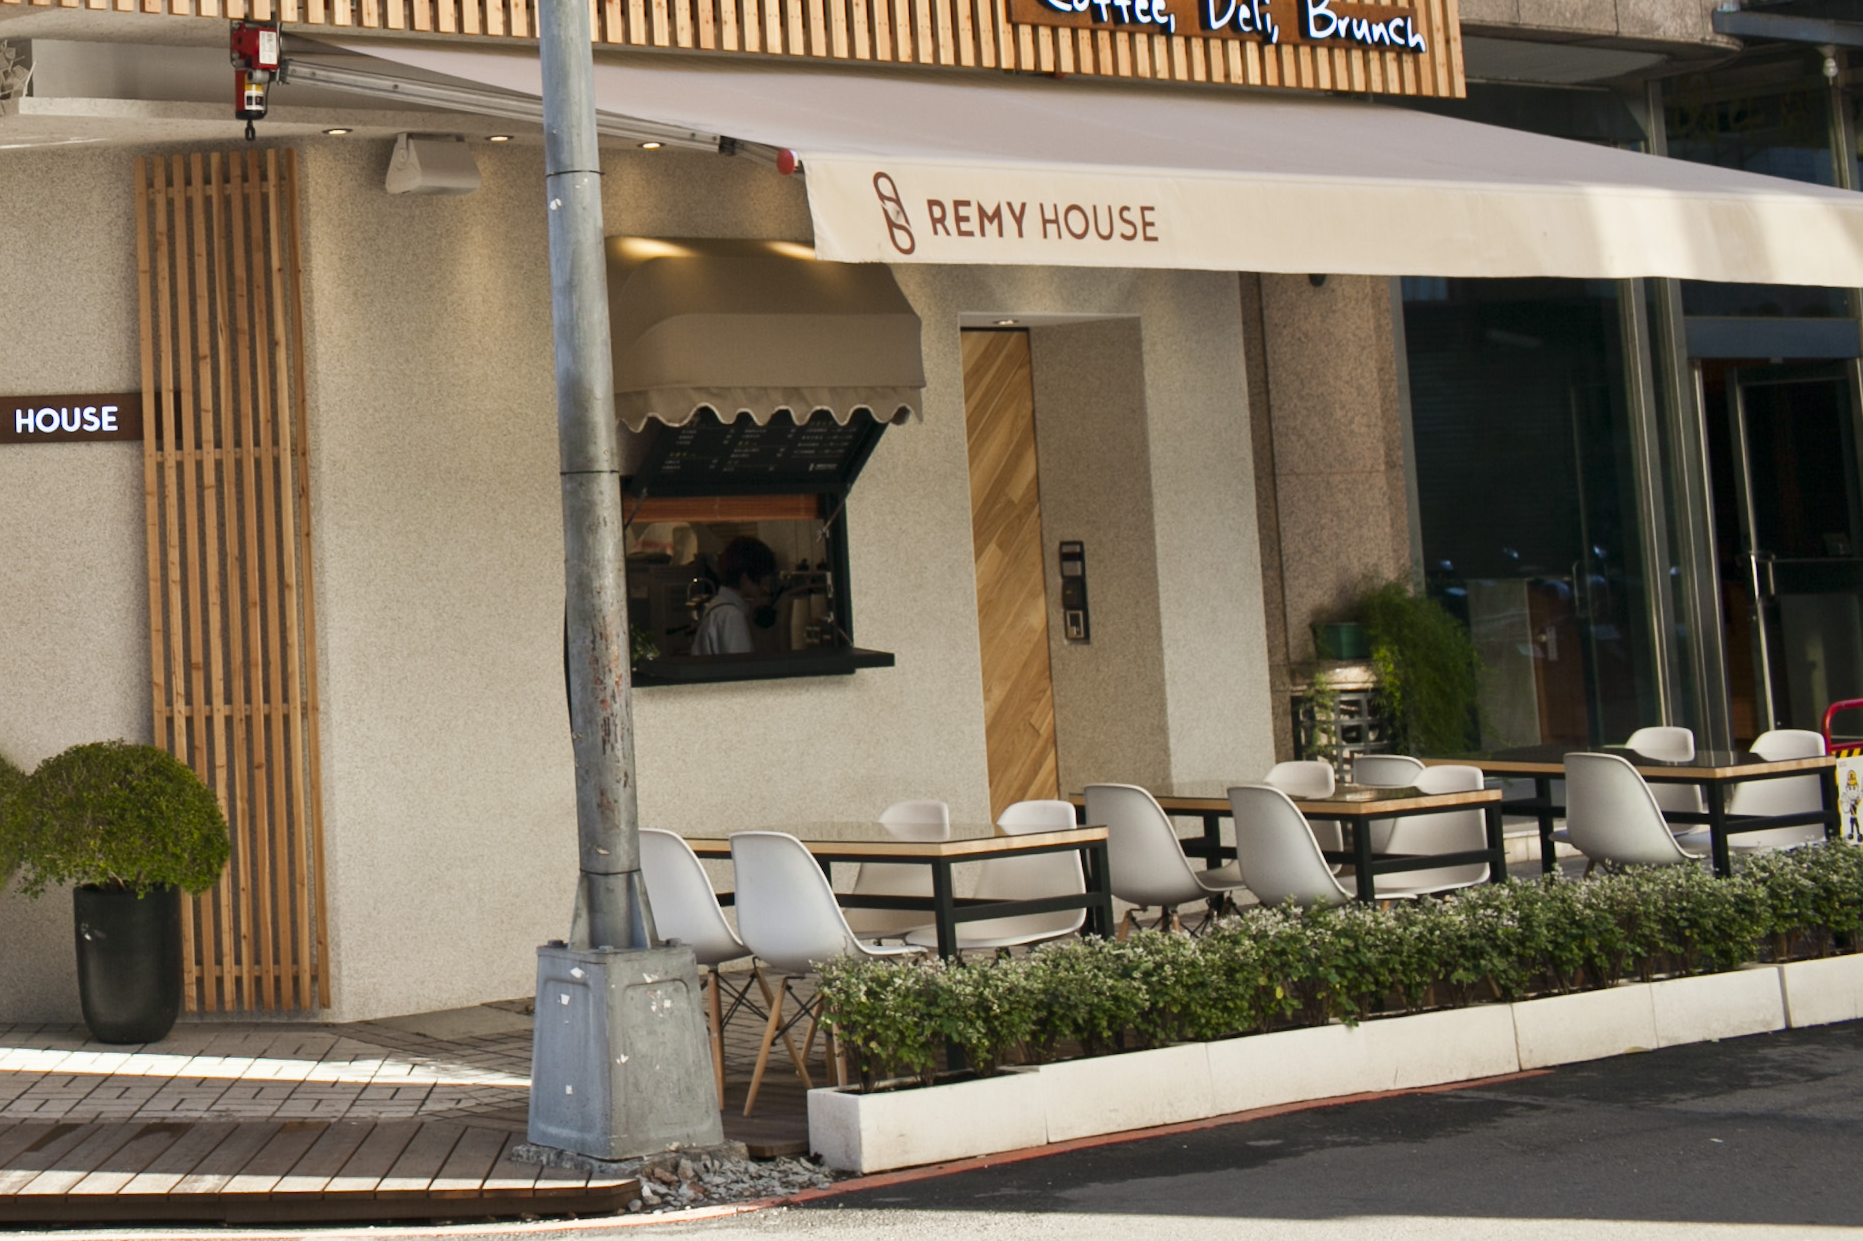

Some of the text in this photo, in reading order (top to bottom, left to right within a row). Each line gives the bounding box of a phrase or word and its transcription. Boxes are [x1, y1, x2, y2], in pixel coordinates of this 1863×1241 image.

[926, 199, 1159, 242] REMY HOUSE
[15, 406, 119, 433] HOUSE
